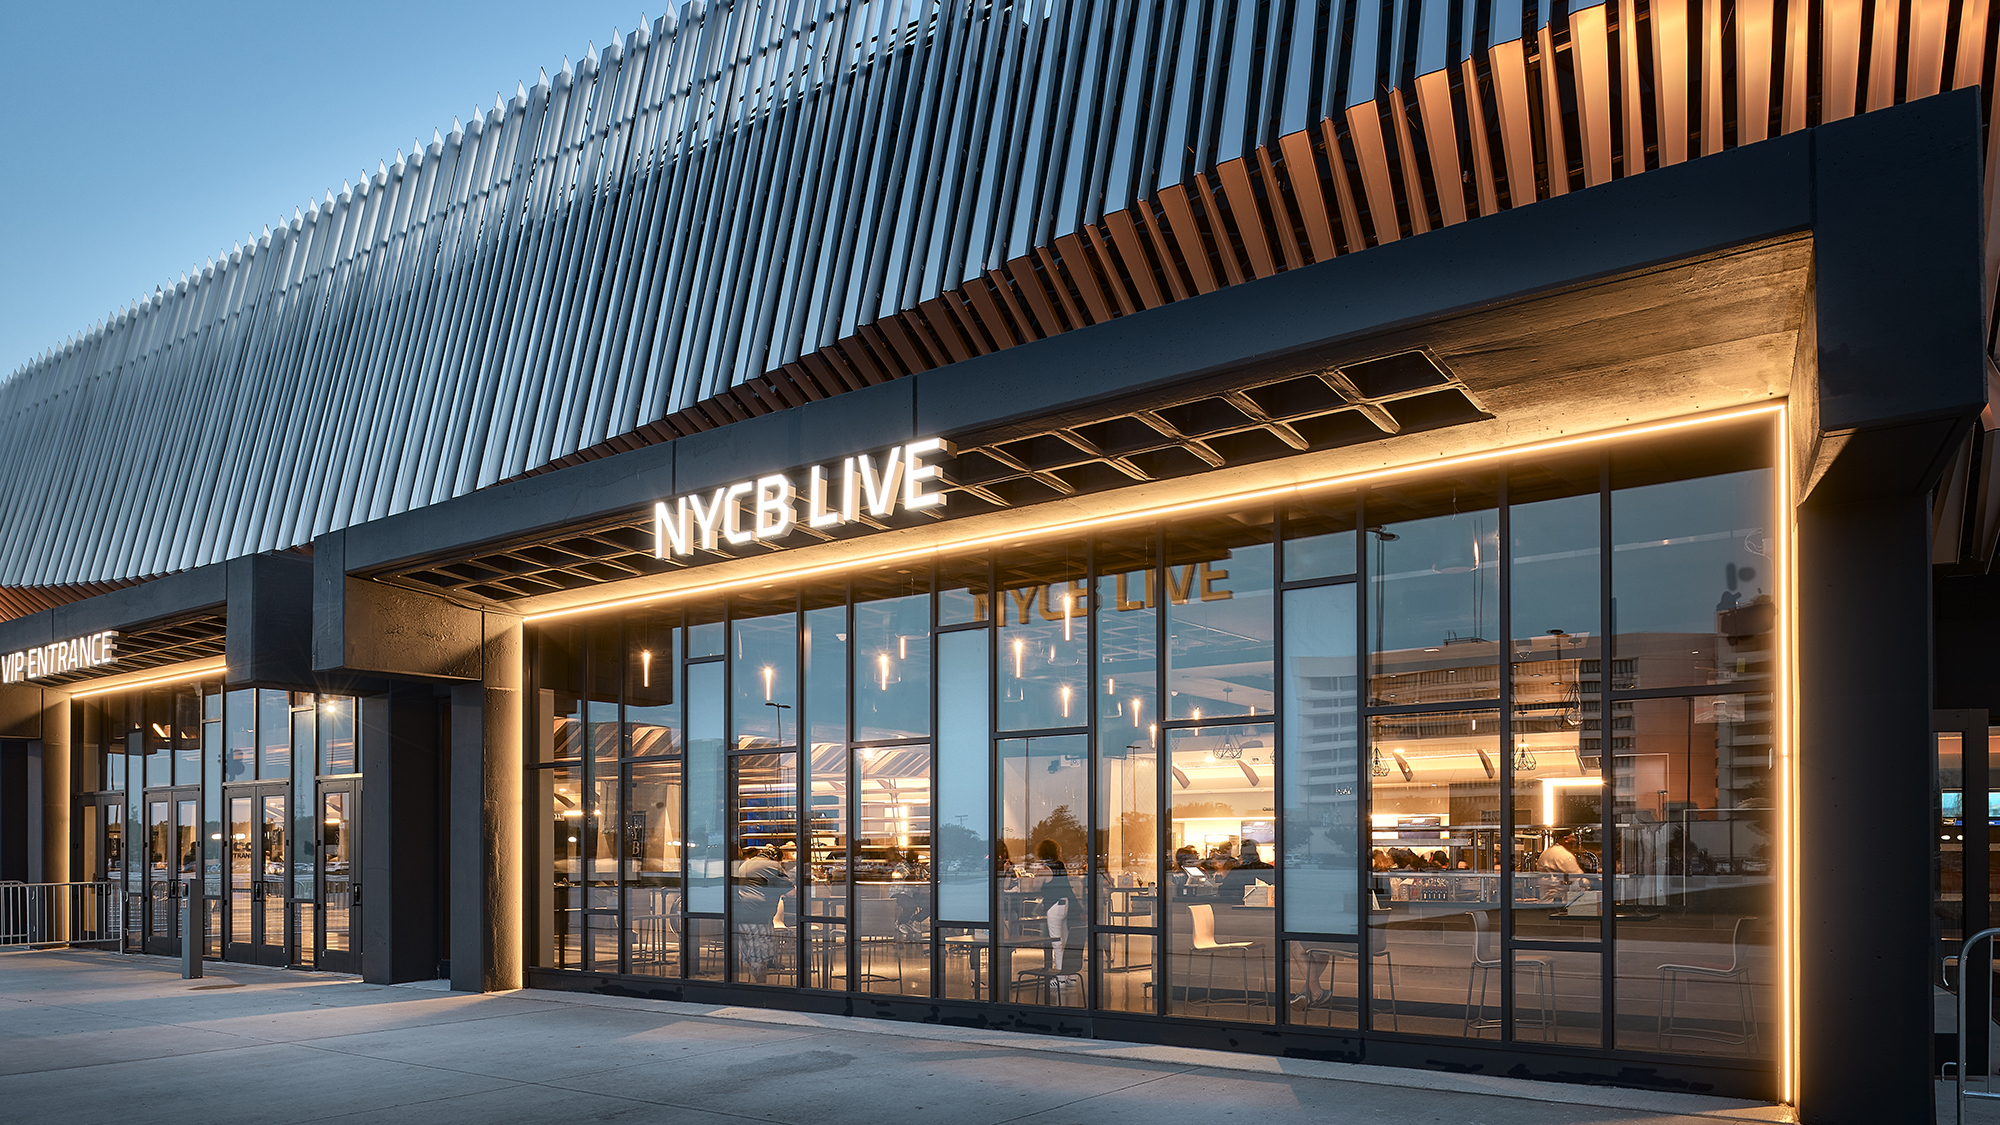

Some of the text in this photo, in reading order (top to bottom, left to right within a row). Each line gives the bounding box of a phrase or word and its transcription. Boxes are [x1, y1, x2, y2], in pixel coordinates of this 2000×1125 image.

[655, 437, 948, 561] NYCB LIVE
[1, 630, 119, 684] VIP ENTRANCE
